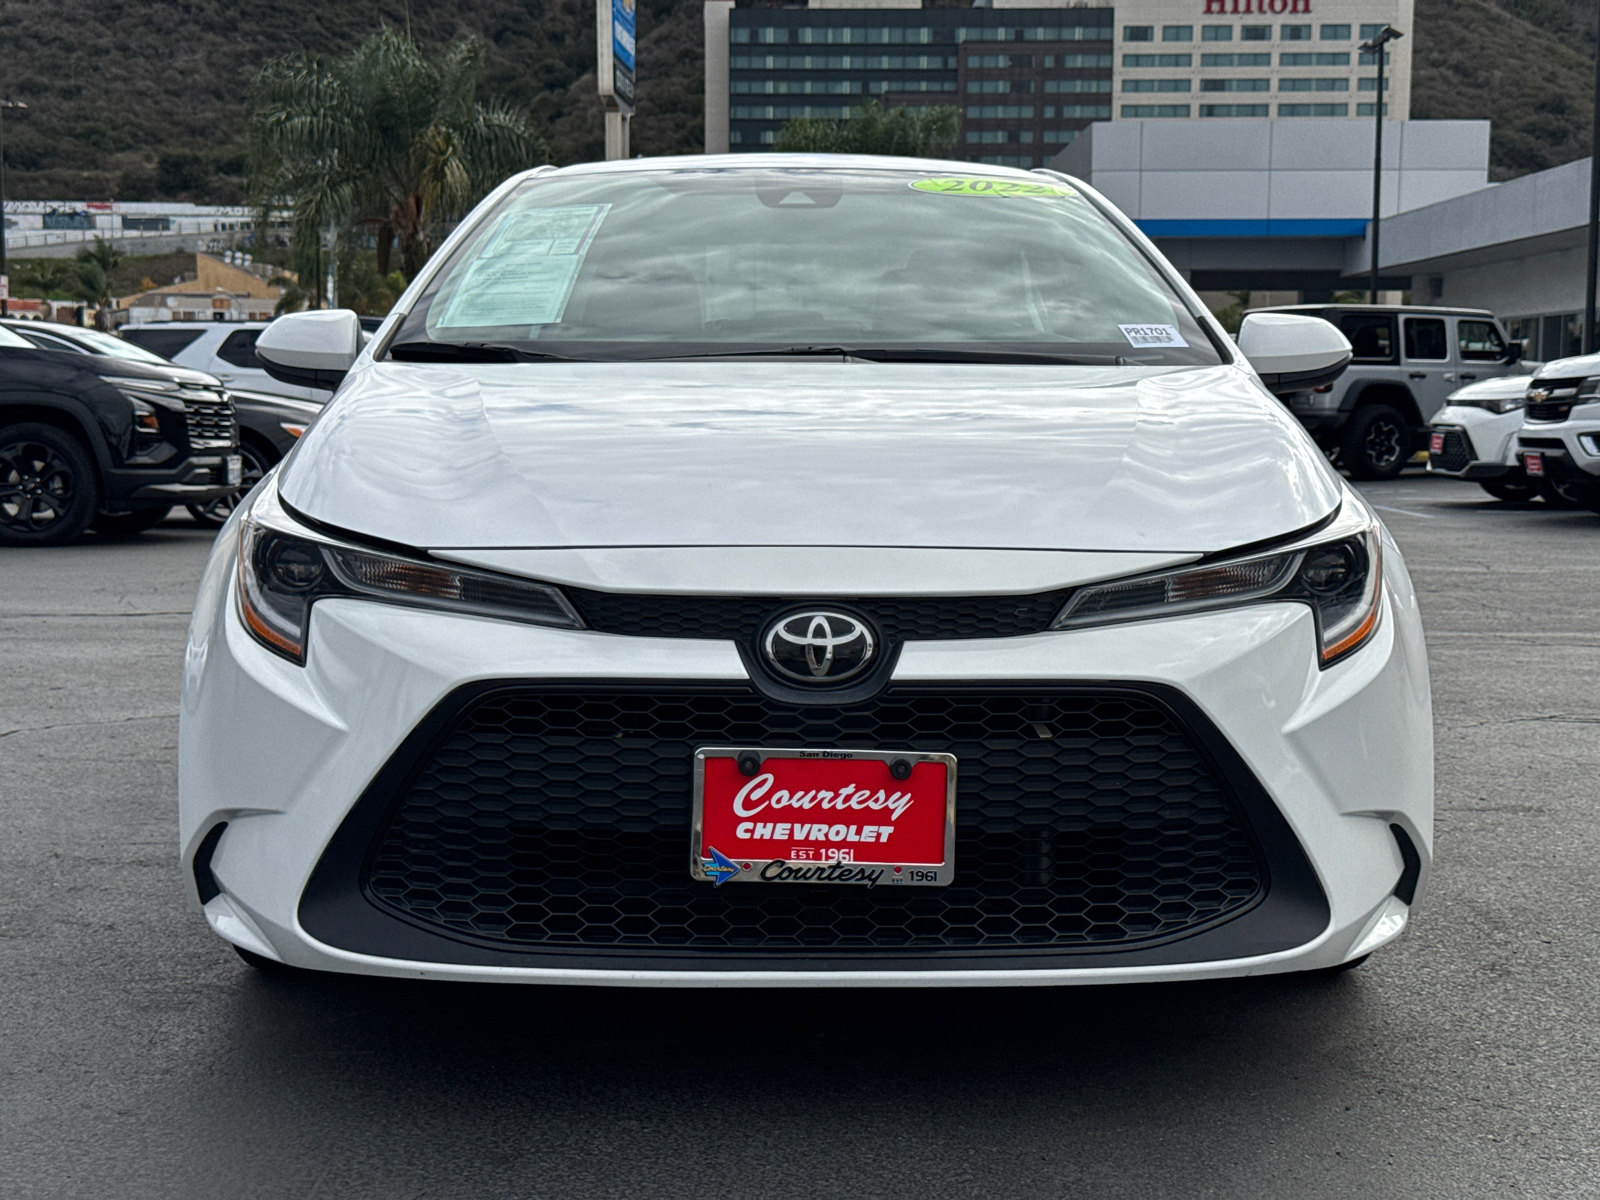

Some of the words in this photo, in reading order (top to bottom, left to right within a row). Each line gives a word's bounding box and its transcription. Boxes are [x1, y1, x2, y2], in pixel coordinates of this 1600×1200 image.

[942, 180, 1046, 194] 2022
[1124, 327, 1171, 336] PR1701
[823, 751, 853, 759] Diego
[733, 773, 914, 821] Courtesy
[736, 822, 894, 843] CHEVROLET
[791, 850, 815, 859] EST
[820, 848, 854, 862] 1961
[703, 864, 736, 873] Courtesy
[760, 859, 885, 889] Courtesy
[909, 870, 938, 882] 1961
